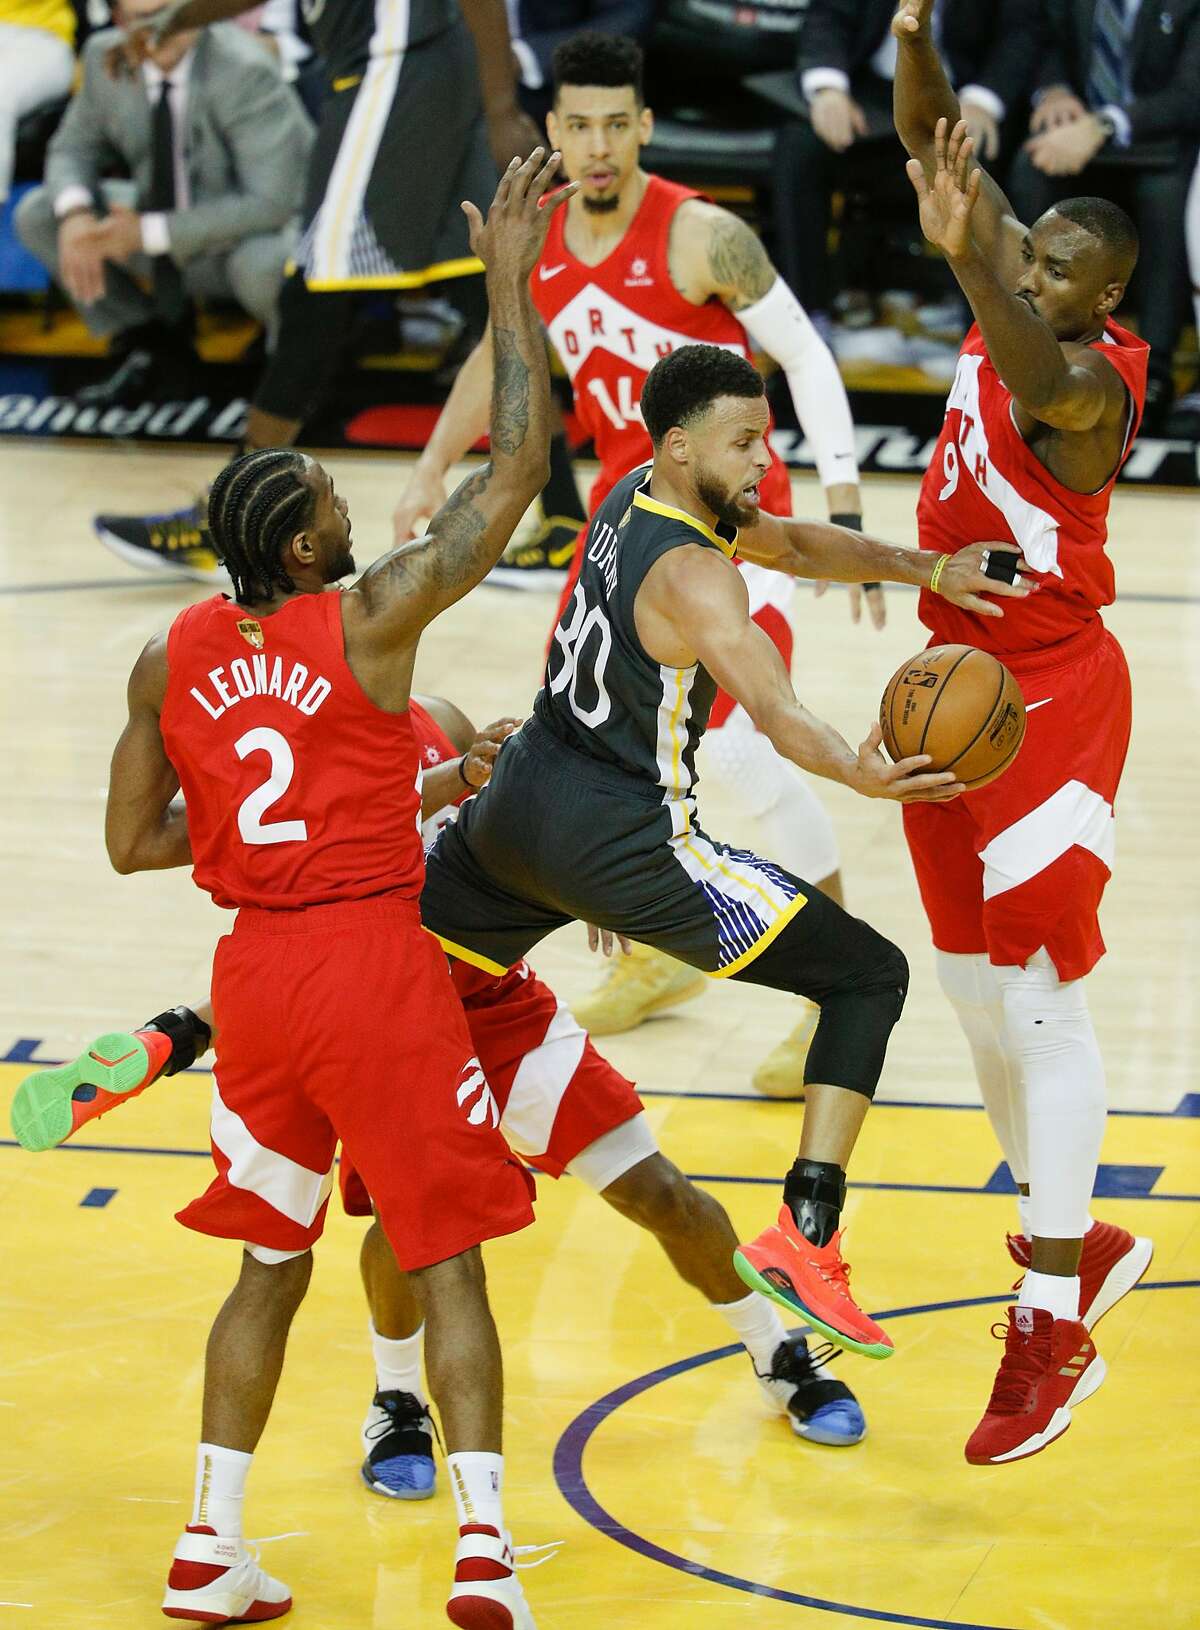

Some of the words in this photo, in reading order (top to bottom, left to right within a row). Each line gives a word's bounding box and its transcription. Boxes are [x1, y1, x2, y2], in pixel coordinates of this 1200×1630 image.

[586, 376, 643, 431] 14
[938, 441, 960, 502] 9
[189, 653, 332, 721] LEONARD
[233, 726, 308, 845] 2
